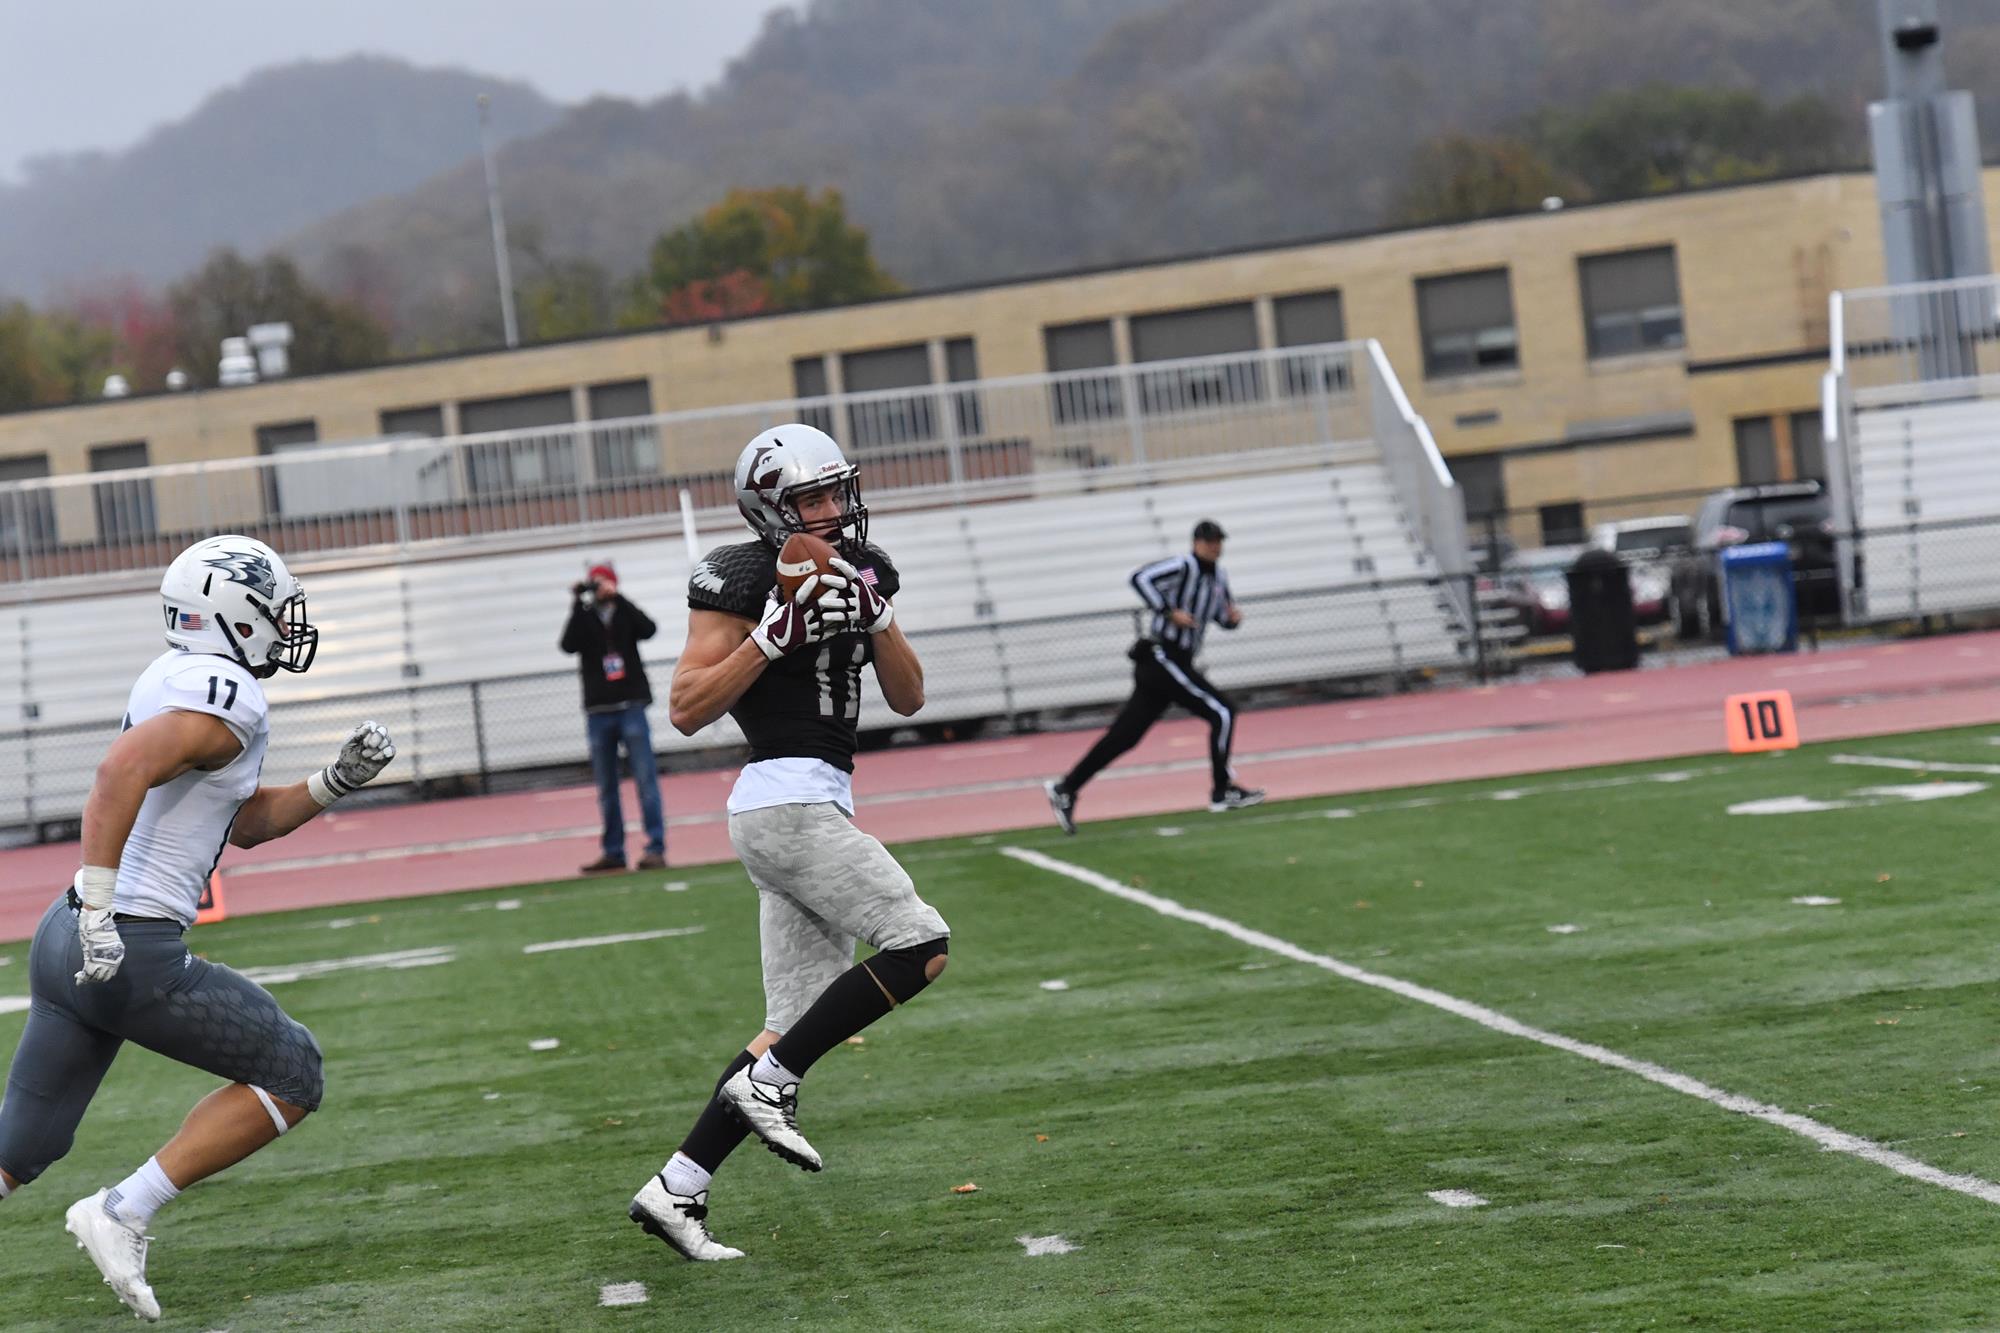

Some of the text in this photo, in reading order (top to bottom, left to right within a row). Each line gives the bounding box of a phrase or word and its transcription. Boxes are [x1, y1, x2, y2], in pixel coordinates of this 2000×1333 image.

[207, 675, 238, 711] 17
[815, 643, 864, 718] 11
[1740, 700, 1783, 740] 10
